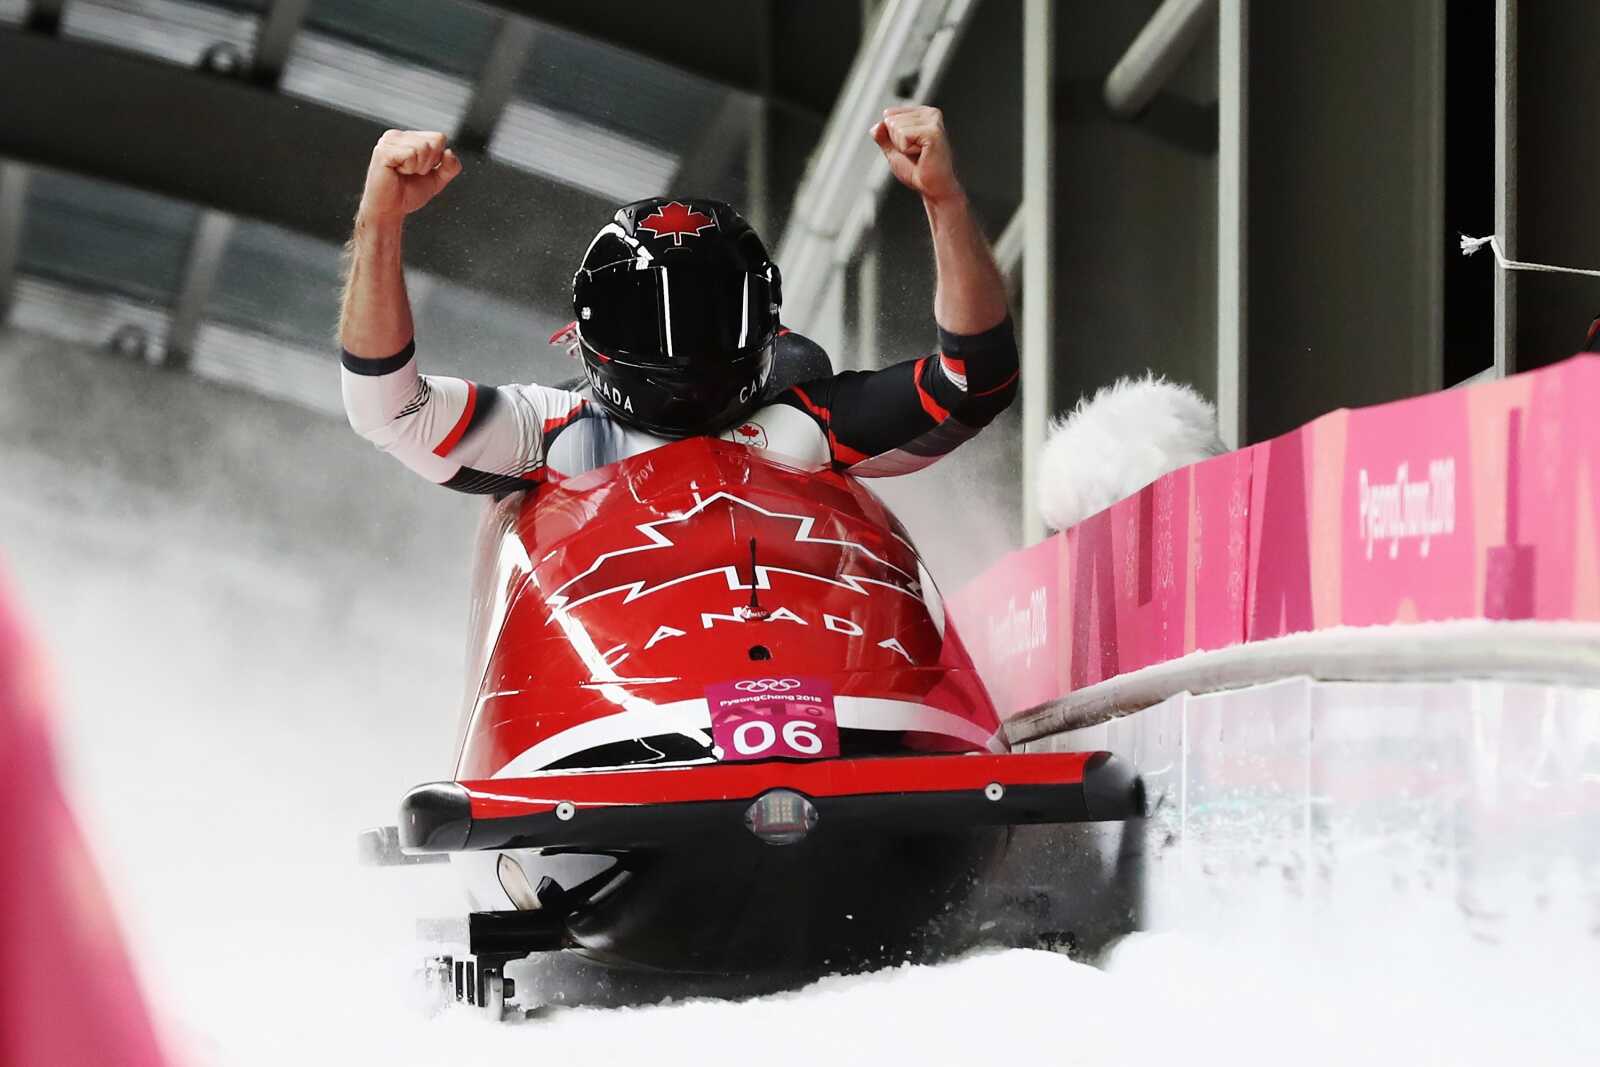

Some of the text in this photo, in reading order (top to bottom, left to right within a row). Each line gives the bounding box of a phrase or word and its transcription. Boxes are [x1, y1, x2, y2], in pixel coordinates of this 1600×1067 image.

[720, 694, 822, 707] PyeongChang 2018
[733, 720, 823, 755] 06
